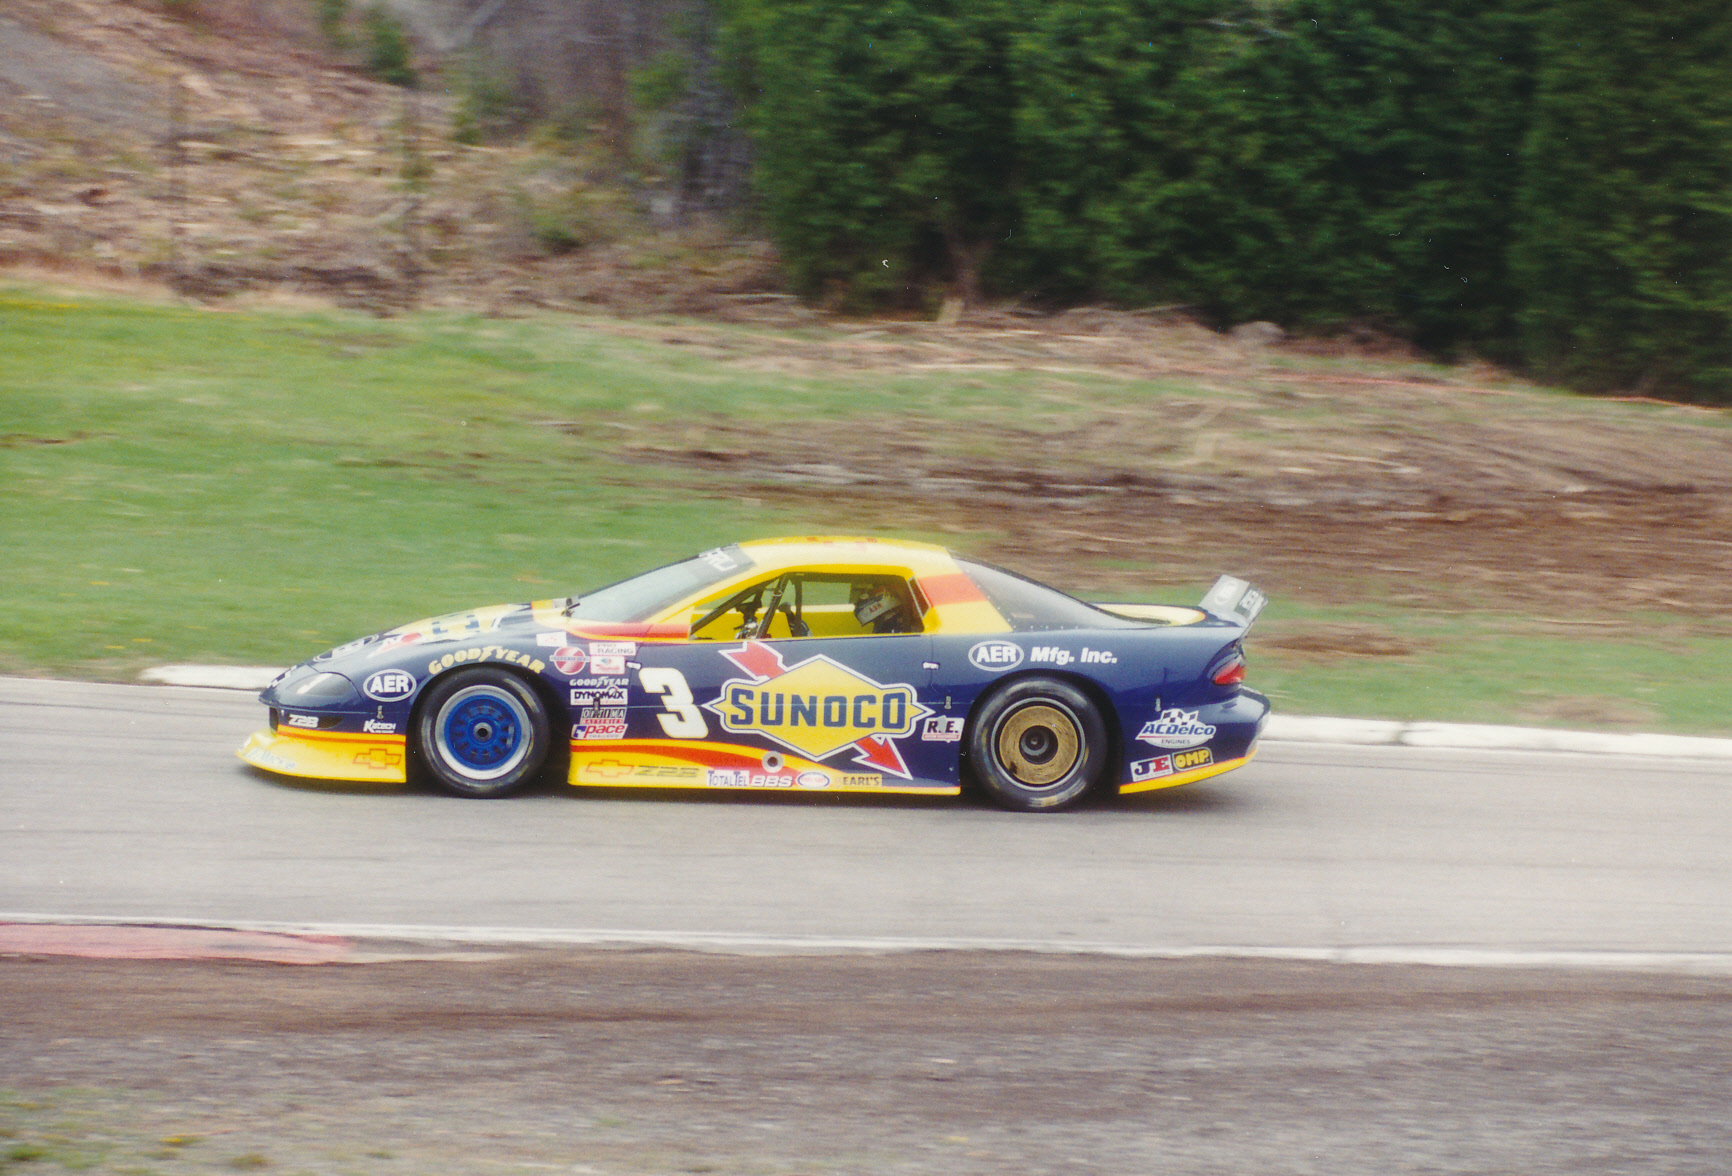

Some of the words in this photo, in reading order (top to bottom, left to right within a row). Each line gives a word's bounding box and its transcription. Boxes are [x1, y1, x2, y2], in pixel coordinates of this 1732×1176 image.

[428, 645, 546, 675] GOODYEAR
[977, 646, 1016, 663] AER
[1030, 647, 1075, 666] Mfg.
[1080, 647, 1118, 664] Inc.
[369, 674, 409, 693] AER
[569, 676, 630, 688] GOODYEAR
[574, 689, 625, 700] DYNOMAX
[638, 667, 709, 739] 3
[730, 687, 906, 729] SUNOCO
[584, 724, 625, 739] pace
[1141, 722, 1215, 736] ACDelco
[1134, 756, 1170, 776] JE
[1175, 749, 1210, 768] OMP
[750, 775, 793, 787] BBS
[842, 775, 880, 786] EARL'S
